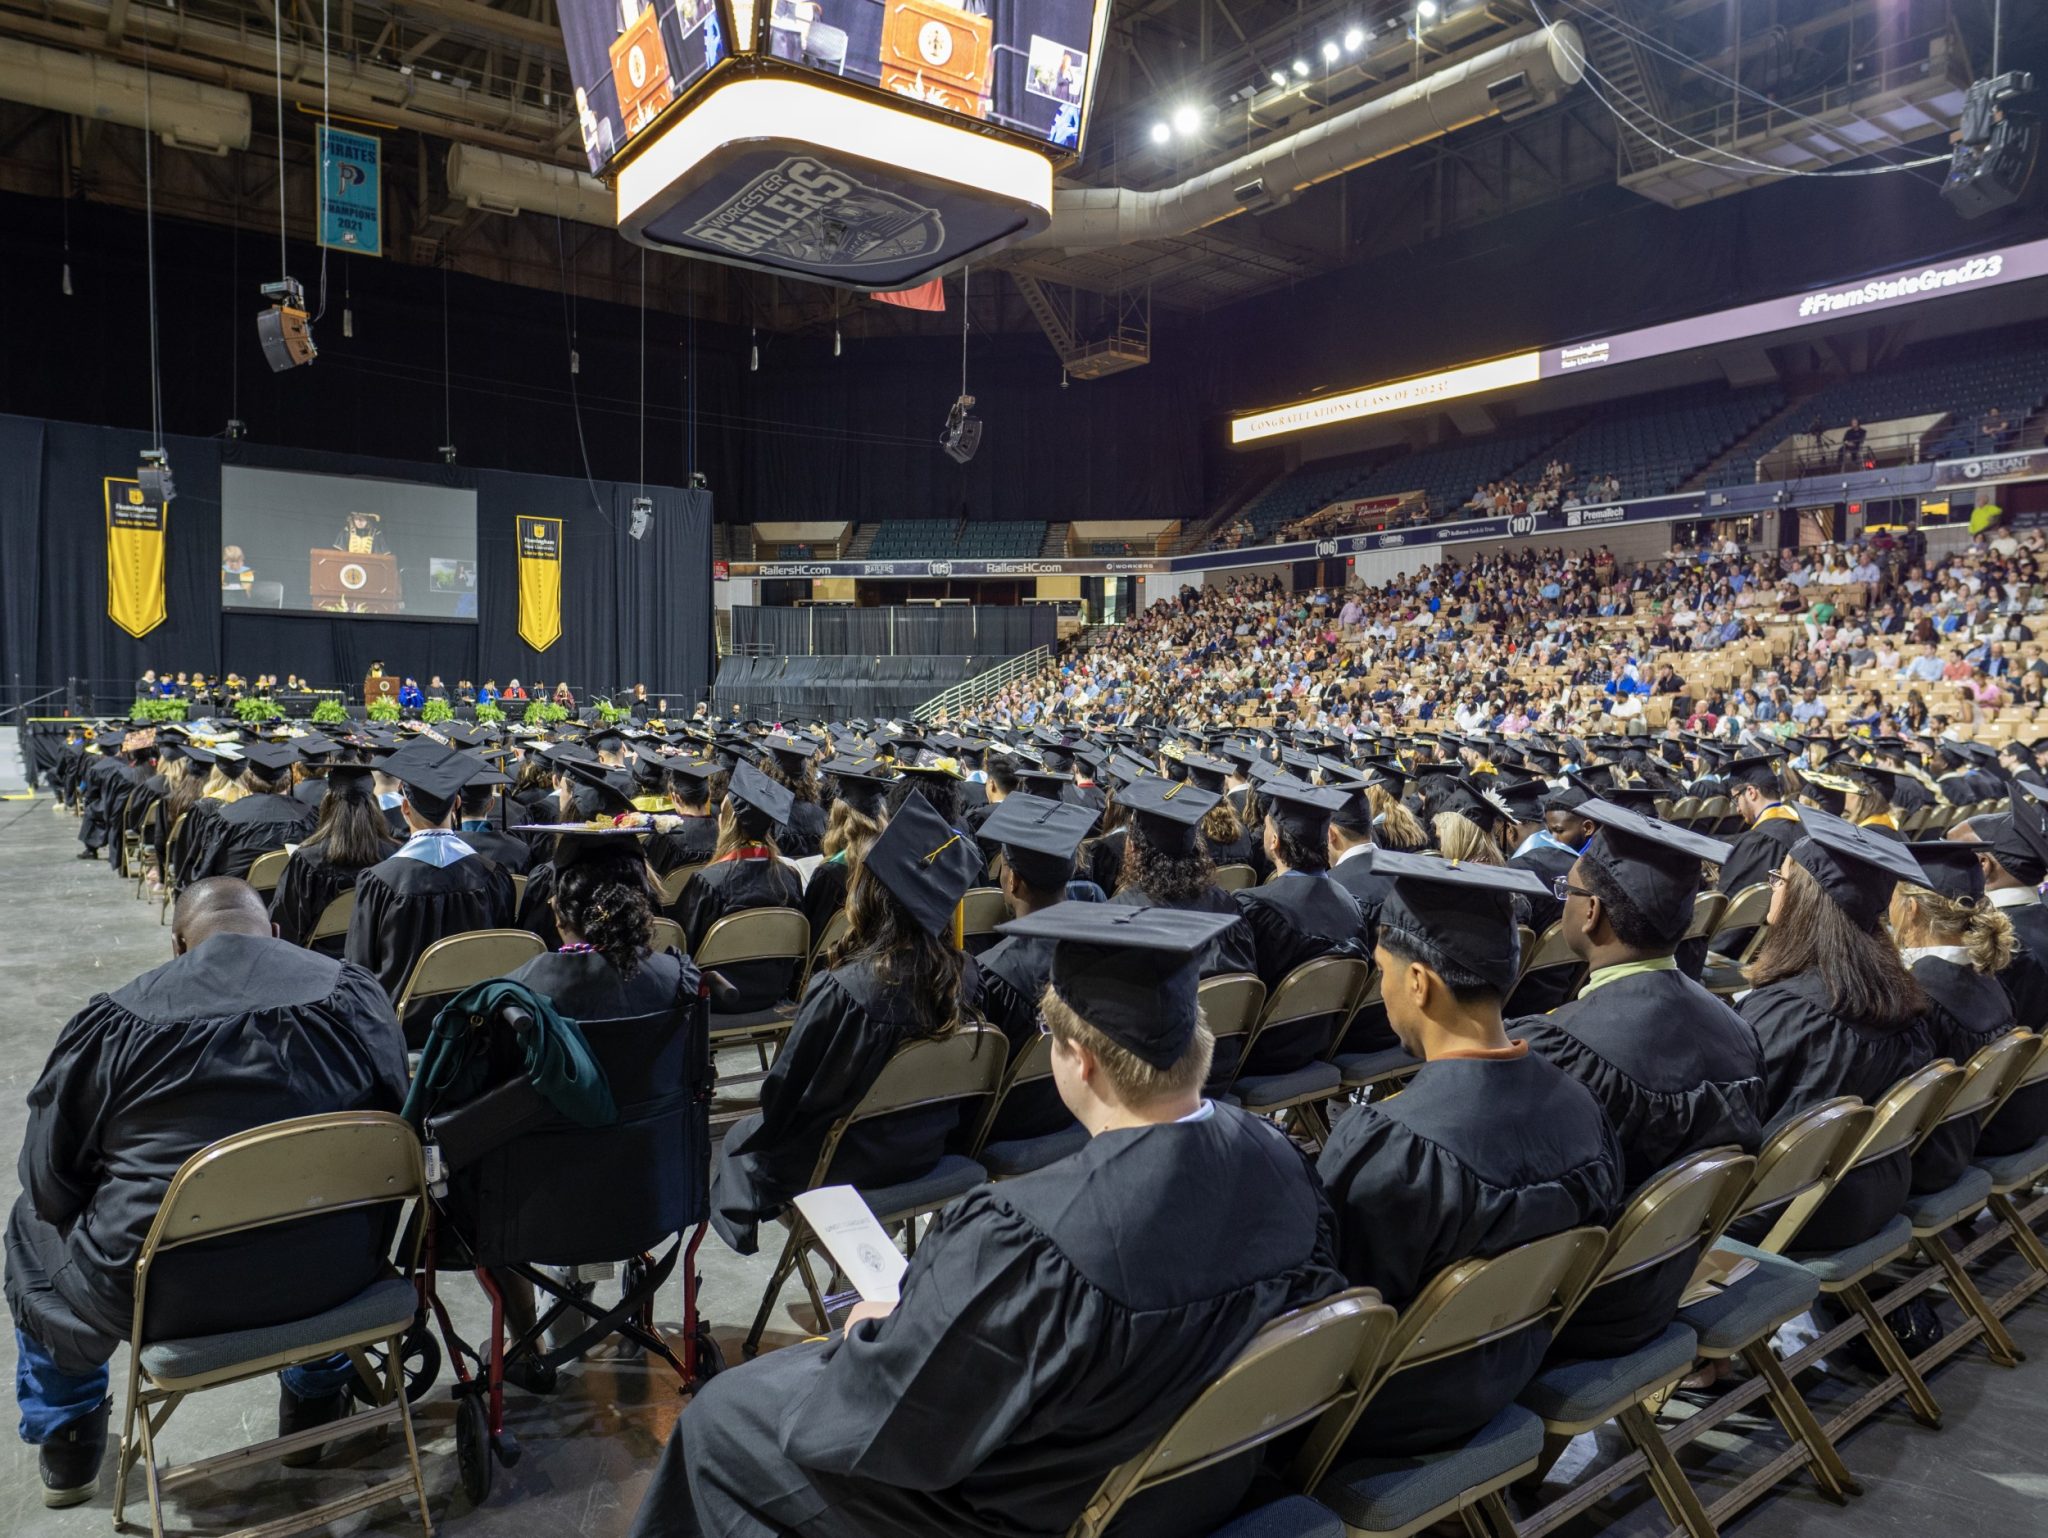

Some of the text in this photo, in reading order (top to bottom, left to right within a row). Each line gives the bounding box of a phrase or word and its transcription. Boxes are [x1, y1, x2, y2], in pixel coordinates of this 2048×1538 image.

[321, 141, 377, 164] PIRATES
[696, 161, 852, 252] RAILERS
[707, 174, 788, 229] WORCESTER
[337, 217, 363, 232] 2021
[1799, 255, 2003, 317] #FramStateGrad23
[1250, 403, 1352, 433] CONGRATULATIONS
[1354, 395, 1391, 409] CLASS
[1394, 389, 1409, 401] OF
[1982, 455, 2031, 471] RELIANT
[1583, 507, 1624, 521] PremaTech
[1511, 517, 1532, 533] 107
[1318, 540, 1335, 555] 106
[759, 565, 831, 576] RailersHC.com
[864, 564, 894, 575] RAILERS
[931, 563, 949, 575] 105
[986, 562, 1062, 573] RailersHC.com
